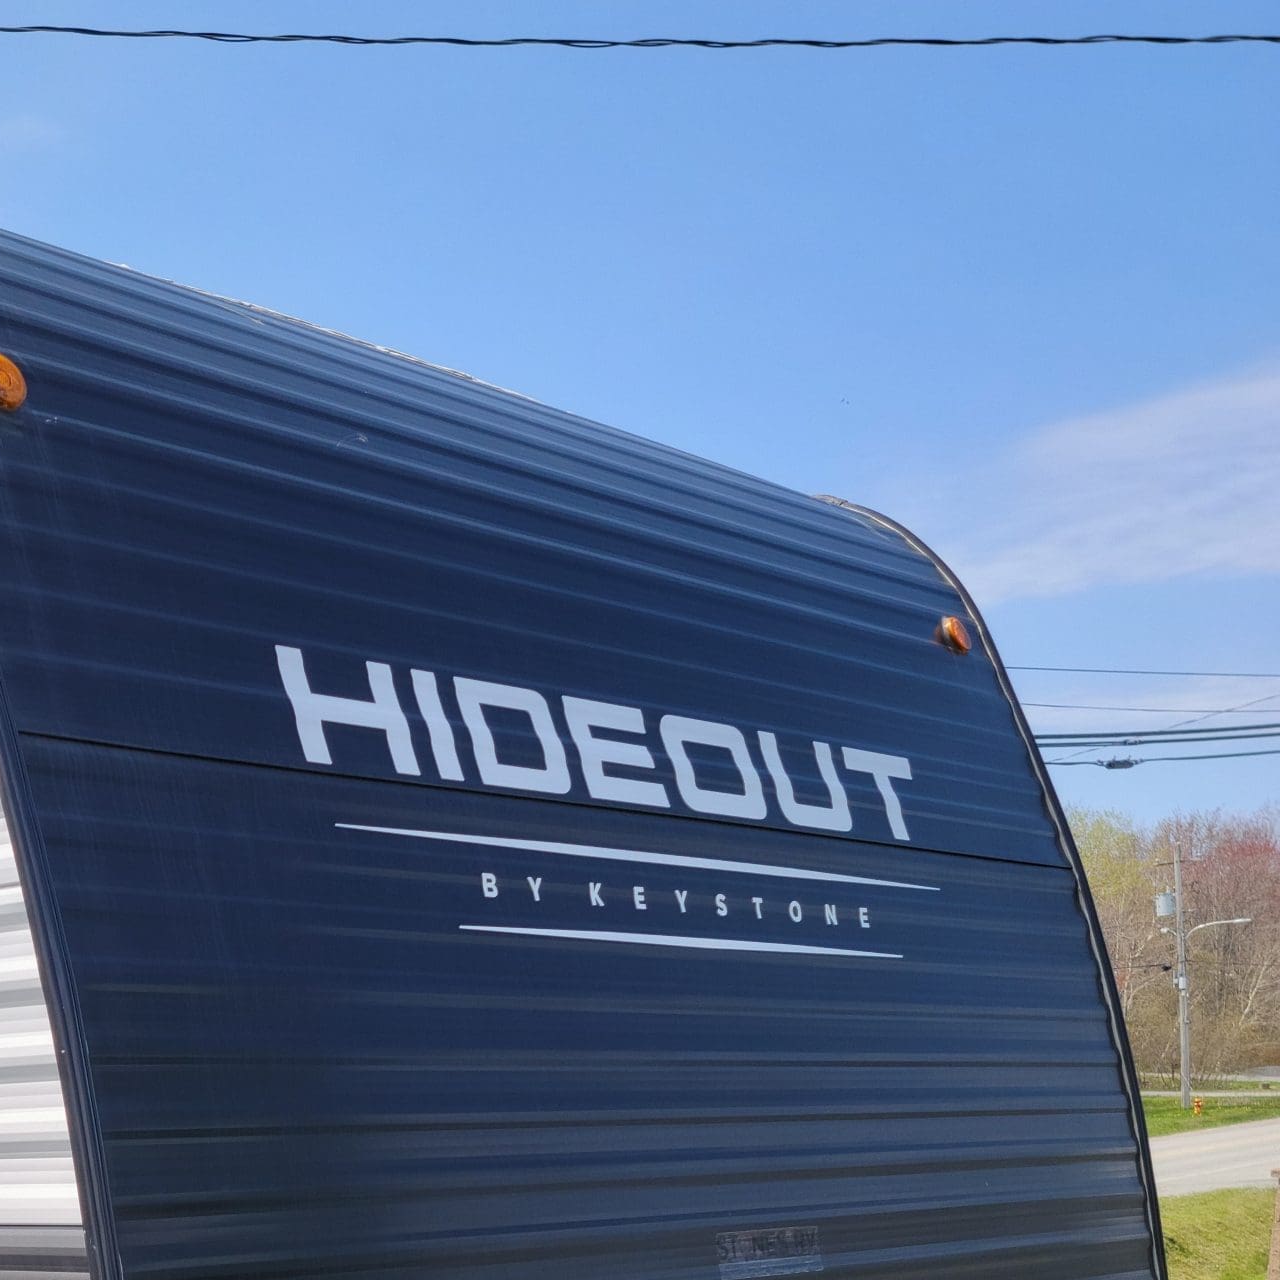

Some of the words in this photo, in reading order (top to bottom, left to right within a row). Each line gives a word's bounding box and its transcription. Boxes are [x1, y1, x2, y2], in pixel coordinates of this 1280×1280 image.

[274, 644, 914, 841] HIDEOUT
[481, 872, 543, 902] BY
[588, 881, 871, 929] KEYSTONE
